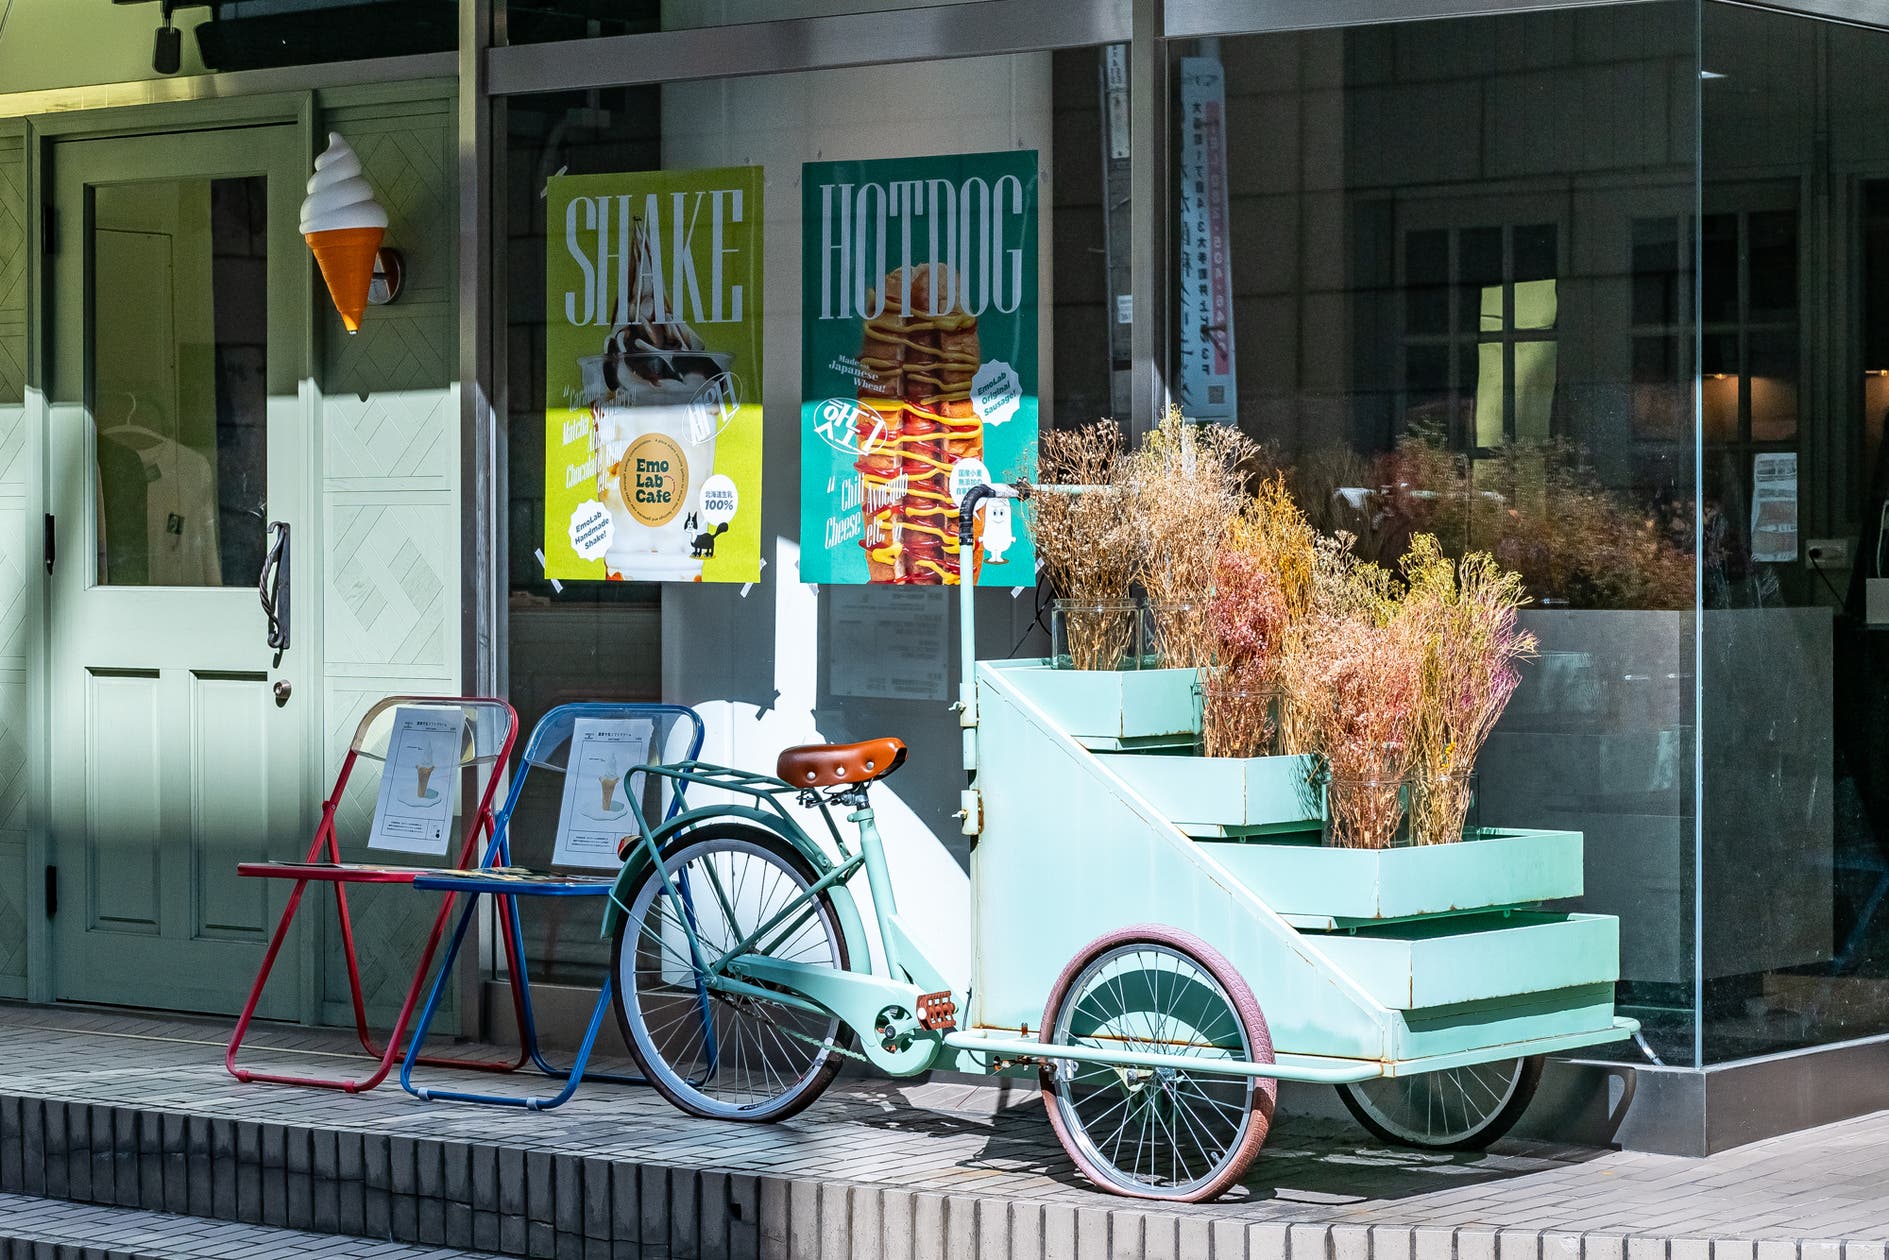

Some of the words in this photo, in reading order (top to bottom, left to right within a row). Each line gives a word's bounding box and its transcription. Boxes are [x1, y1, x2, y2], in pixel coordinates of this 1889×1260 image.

[565, 189, 743, 326] SHAKE
[818, 175, 1023, 320] HOTDOG
[828, 360, 879, 381] Japanese
[838, 354, 859, 366] Made
[853, 377, 886, 393] Wheat!
[977, 371, 1007, 396] EmoLab
[982, 380, 1011, 404] Original
[984, 389, 1016, 416] Sausage!
[636, 458, 669, 473] Emo
[636, 473, 664, 488] Lab
[635, 489, 672, 504] Cafe
[705, 490, 733, 498] 北海道生乳
[841, 472, 865, 512] Chili
[866, 467, 909, 516] Avocado
[705, 499, 733, 510] 100%
[574, 518, 609, 545] Handmade
[575, 511, 602, 533] EmoLab
[824, 511, 861, 550] Cheese
[584, 529, 607, 550] Shake!
